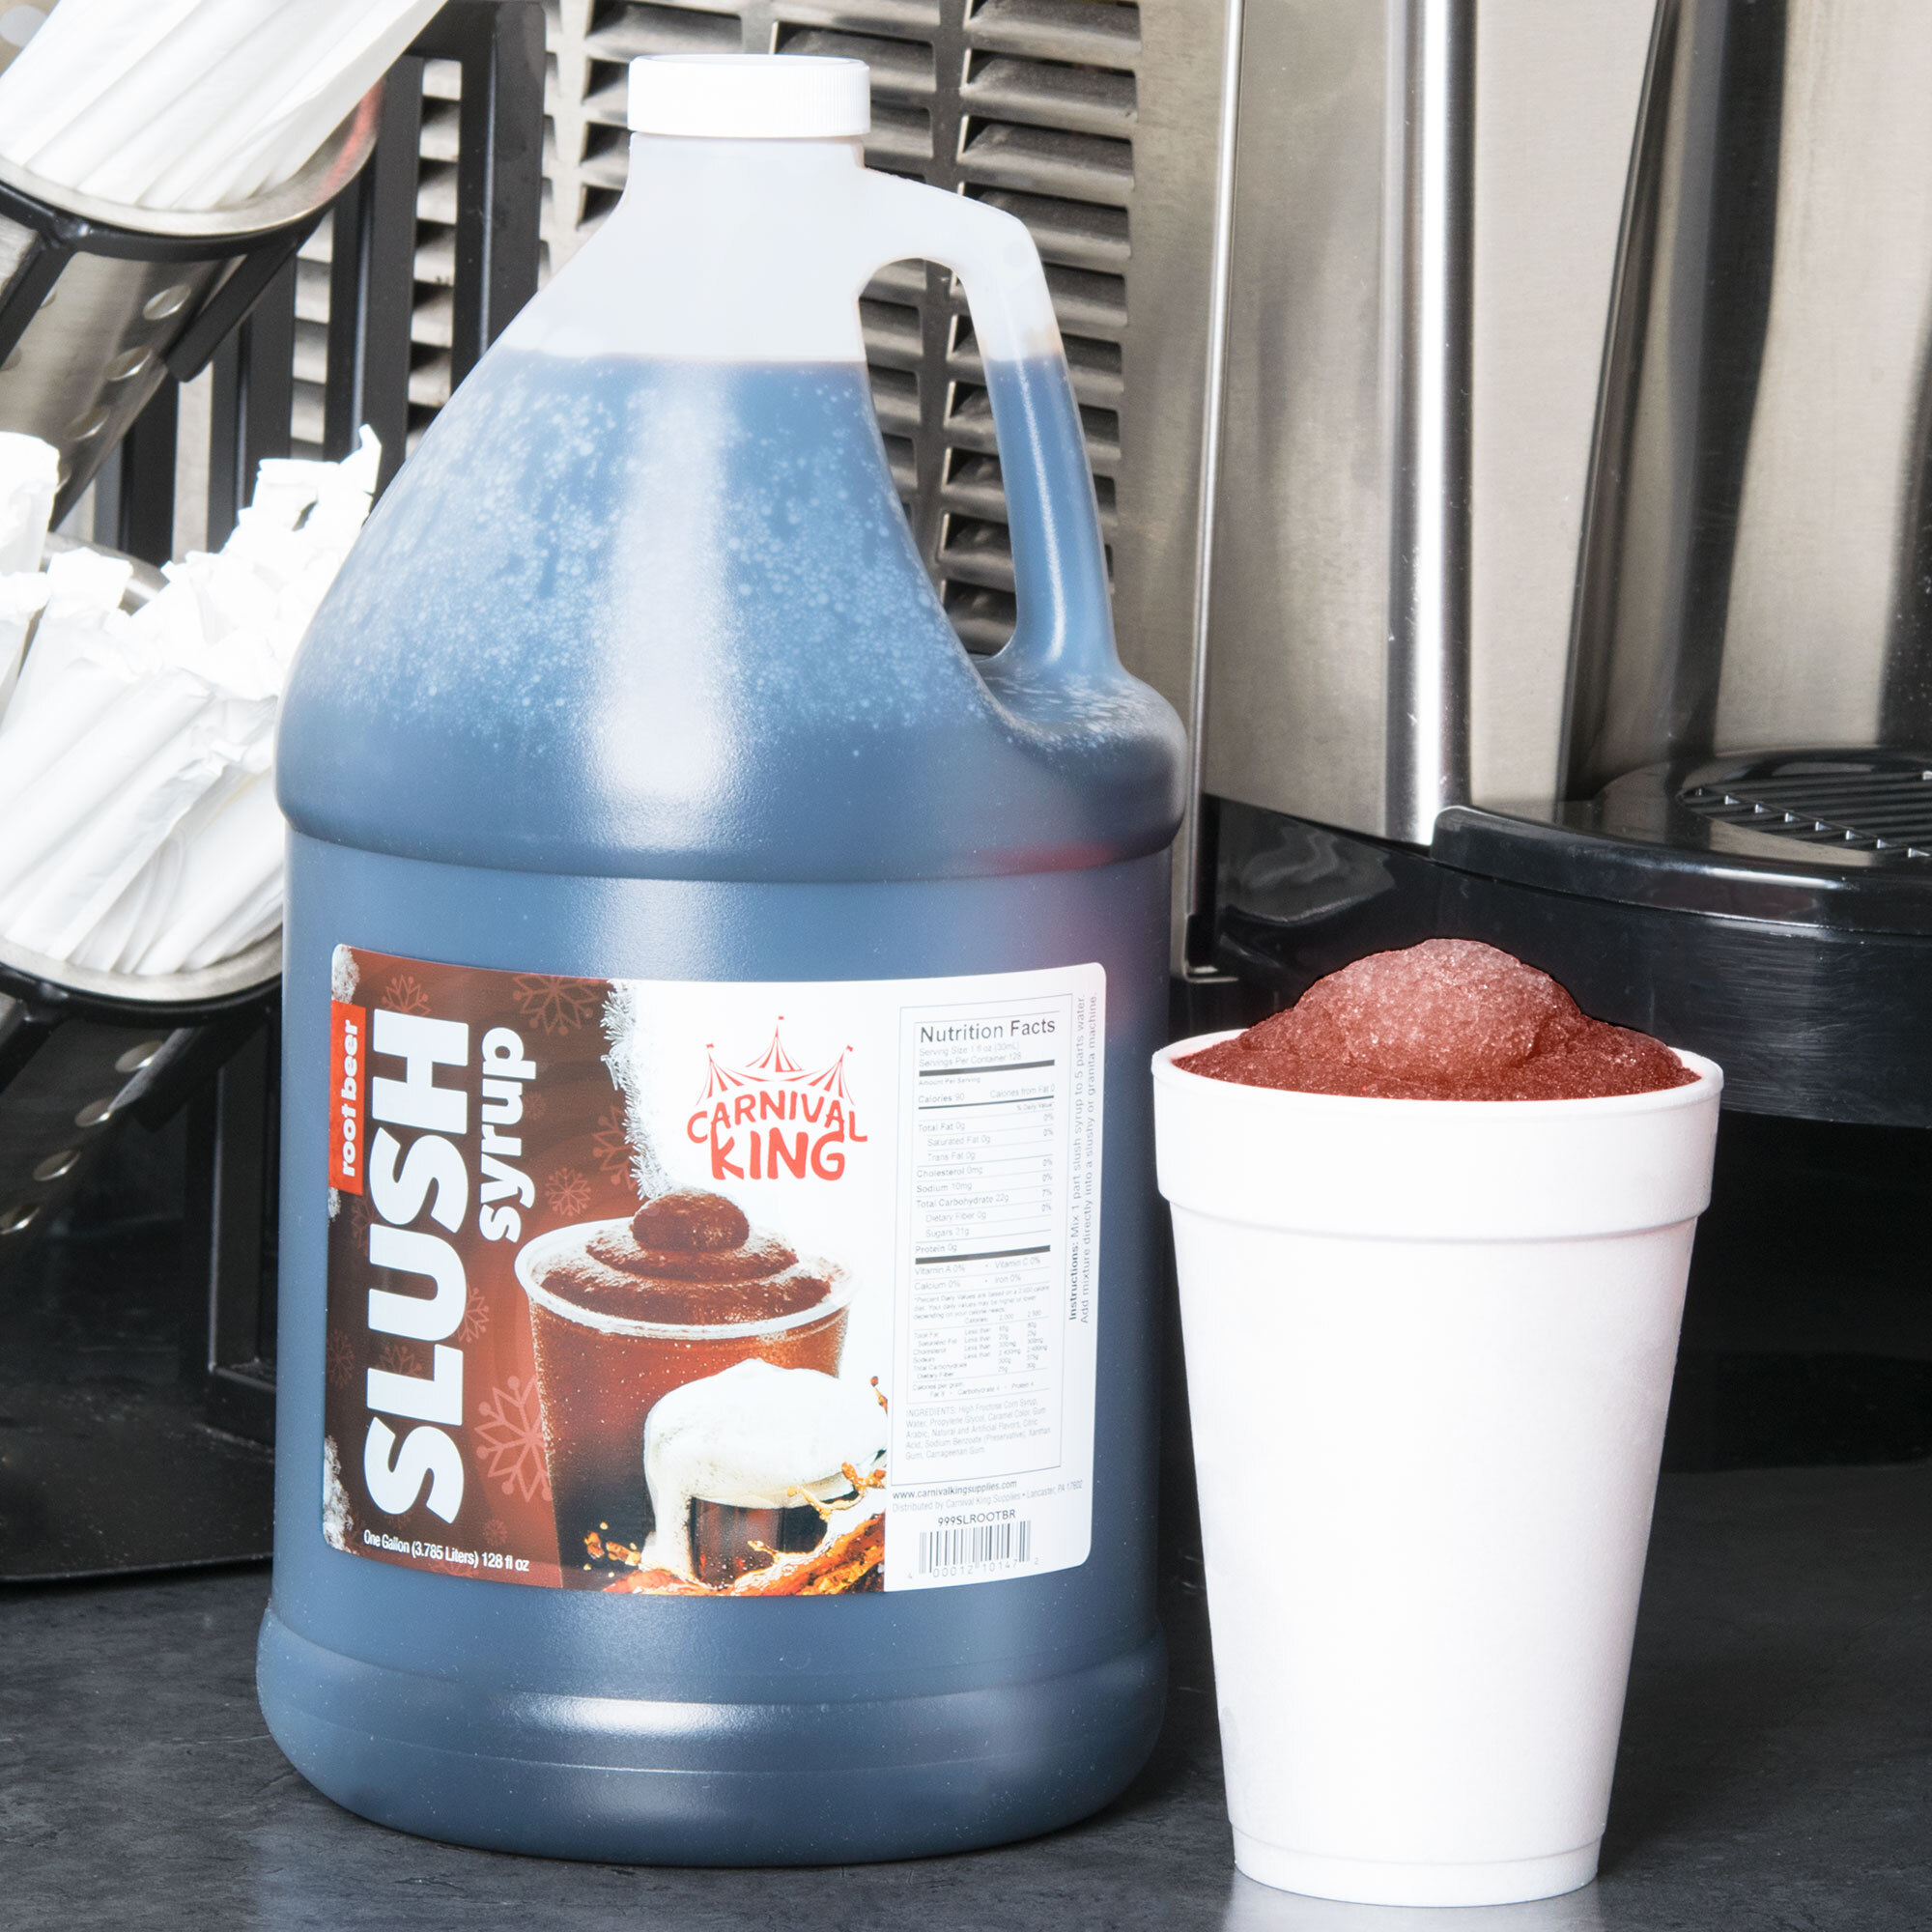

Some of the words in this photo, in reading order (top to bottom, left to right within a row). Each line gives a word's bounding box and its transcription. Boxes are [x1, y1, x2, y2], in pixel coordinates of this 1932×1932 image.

[921, 1024, 1003, 1043] Nutrition
[1010, 1018, 1056, 1037] Facts
[341, 1019, 357, 1101] beer
[920, 1047, 949, 1057] Serving
[952, 1046, 967, 1055] Size
[1076, 1035, 1085, 1066] parts
[920, 1059, 952, 1067] Servings
[955, 1056, 969, 1065] Per
[972, 1054, 1007, 1064] Container
[1074, 1070, 1083, 1079] 5
[1088, 1053, 1096, 1096] granita
[918, 1094, 952, 1103] Calories
[955, 1093, 965, 1101] 90
[990, 1089, 1019, 1098] Calories
[1021, 1087, 1037, 1095] from
[1038, 1085, 1049, 1094] Fat
[1074, 1082, 1083, 1095] to
[1074, 1098, 1084, 1134] syrup
[1087, 1101, 1094, 1113] or
[687, 1090, 867, 1144] CARNIVAL
[955, 1122, 965, 1130] 0g
[1043, 1113, 1054, 1122] 0%
[341, 1103, 356, 1177] root
[479, 1027, 536, 1243] syrup
[927, 1137, 964, 1147] Saturated
[967, 1135, 980, 1144] Fat
[981, 1134, 990, 1144] 0g
[1043, 1128, 1054, 1137] 0%
[1085, 1117, 1094, 1157] slushy
[711, 1122, 845, 1180] KING
[927, 1152, 949, 1161] Trans
[952, 1151, 963, 1160] Fat
[966, 1151, 976, 1160] 0g
[1072, 1138, 1082, 1172] slush
[917, 1168, 965, 1178] Cholesterol
[967, 1166, 983, 1175] 0mg
[1042, 1158, 1053, 1167] 0%
[917, 1183, 948, 1192] Sodium
[952, 1182, 972, 1191] 10mg
[1042, 1174, 1053, 1182] 0%
[1072, 1176, 1082, 1200] part
[1084, 1172, 1093, 1195] into
[917, 1200, 937, 1208] Total
[939, 1196, 993, 1207] Carbohydrate
[996, 1194, 1009, 1203] 22g
[925, 1213, 953, 1223] Dietary
[955, 1211, 974, 1220] Fiber
[977, 1210, 986, 1220] 0g
[1041, 1204, 1051, 1212] 0%
[1082, 1200, 1093, 1245] directly
[925, 1229, 953, 1238] Sugars
[955, 1227, 970, 1236] 21g
[1070, 1215, 1080, 1237] Mix
[916, 1244, 945, 1253] Protein
[948, 1243, 957, 1253] 0g
[363, 1009, 469, 1523] SLUSH
[915, 1265, 944, 1276] Vitamin
[952, 1264, 965, 1273] 0%
[995, 1259, 1021, 1268] Vitamin
[1023, 1258, 1029, 1266] C
[1030, 1257, 1041, 1265] 0%
[914, 1282, 947, 1291] Calcium
[949, 1280, 961, 1289] 0%
[995, 1275, 1009, 1284] Iron
[1010, 1273, 1021, 1282] 0%
[1068, 1242, 1079, 1321] Instructions:
[1080, 1300, 1089, 1323] Add
[930, 1416, 963, 1427] Propylene
[988, 1412, 1013, 1421] Caramel
[959, 1406, 974, 1414] High
[932, 1427, 956, 1436] Natural
[924, 1438, 951, 1448] Sodium
[952, 1435, 981, 1445] Benzoate
[892, 1480, 1018, 1499] www.carnivalkingsupplies.com
[893, 1501, 934, 1513] Distributed
[935, 1500, 944, 1510] by
[946, 1496, 974, 1508] Carnival
[976, 1494, 991, 1506] King
[993, 1492, 1021, 1504] Supplies
[1026, 1487, 1056, 1499] Lancaster,
[1057, 1484, 1065, 1492] PA
[938, 1509, 1016, 1526] 999SLROOTBR
[363, 1529, 381, 1547] One
[382, 1534, 410, 1553] Gallon
[412, 1541, 443, 1560] (3.785
[445, 1546, 478, 1568] Liters)
[481, 1552, 503, 1570] 128
[504, 1554, 513, 1570] fl
[515, 1559, 529, 1572] oz
[933, 1565, 974, 1577] 00012
